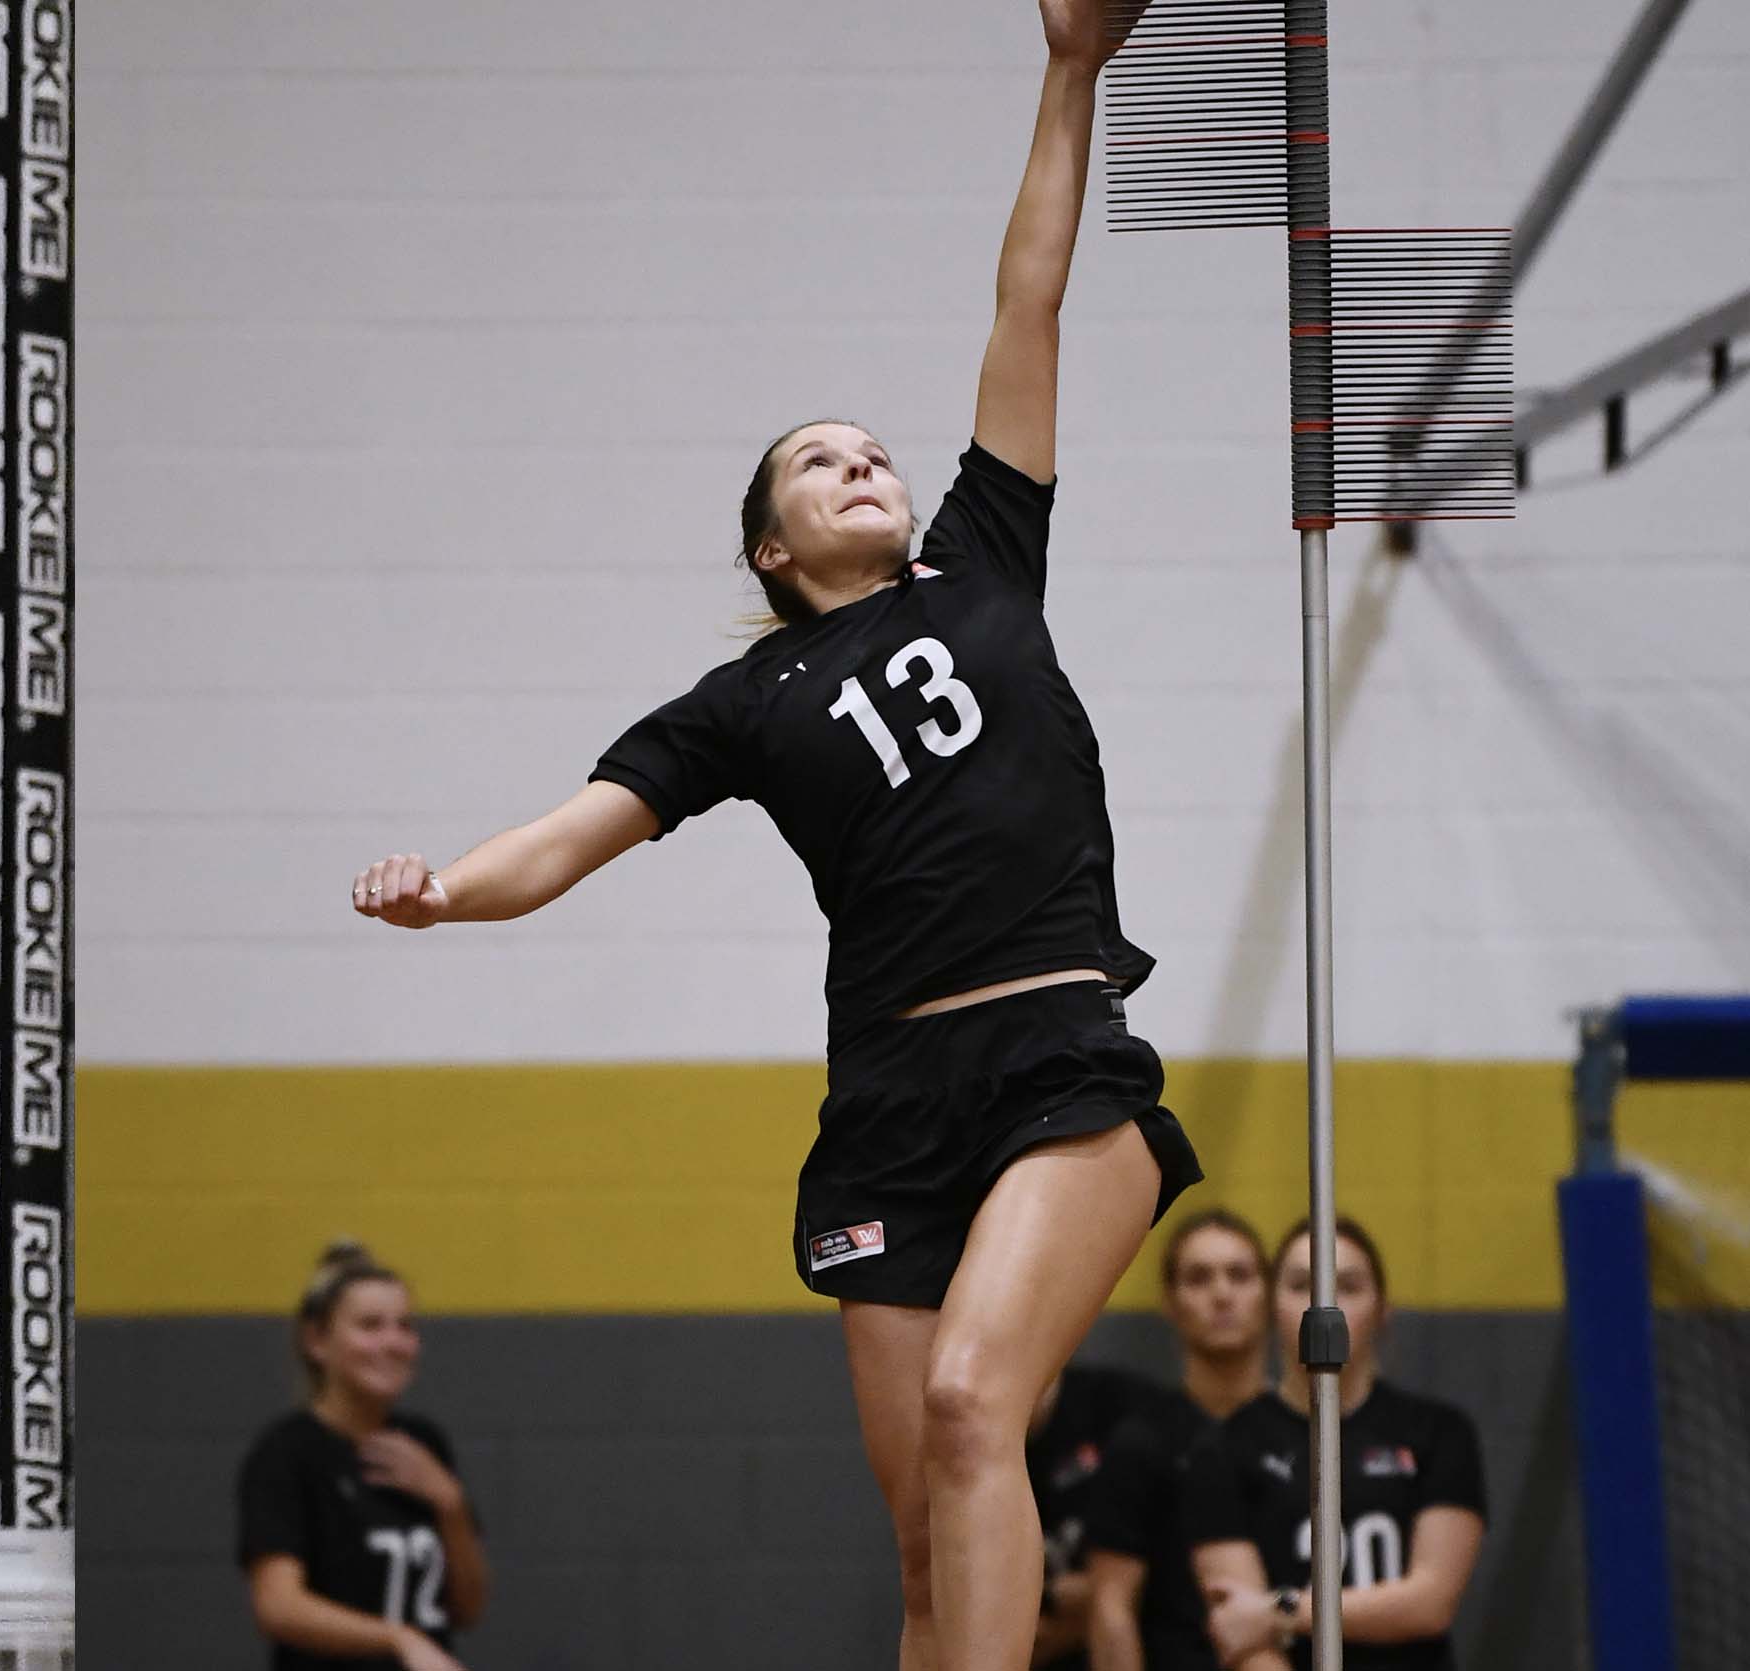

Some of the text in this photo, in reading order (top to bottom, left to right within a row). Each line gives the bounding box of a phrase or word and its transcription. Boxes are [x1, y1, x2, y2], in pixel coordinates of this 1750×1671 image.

[19, 0, 68, 280] OKIE ME
[17, 332, 67, 715] ROOKIE ME
[828, 637, 983, 789] 13
[14, 767, 65, 1150] ROOKIE ME
[12, 1203, 62, 1465] ROOKIE
[14, 1463, 62, 1529] M
[367, 1525, 447, 1628] 72
